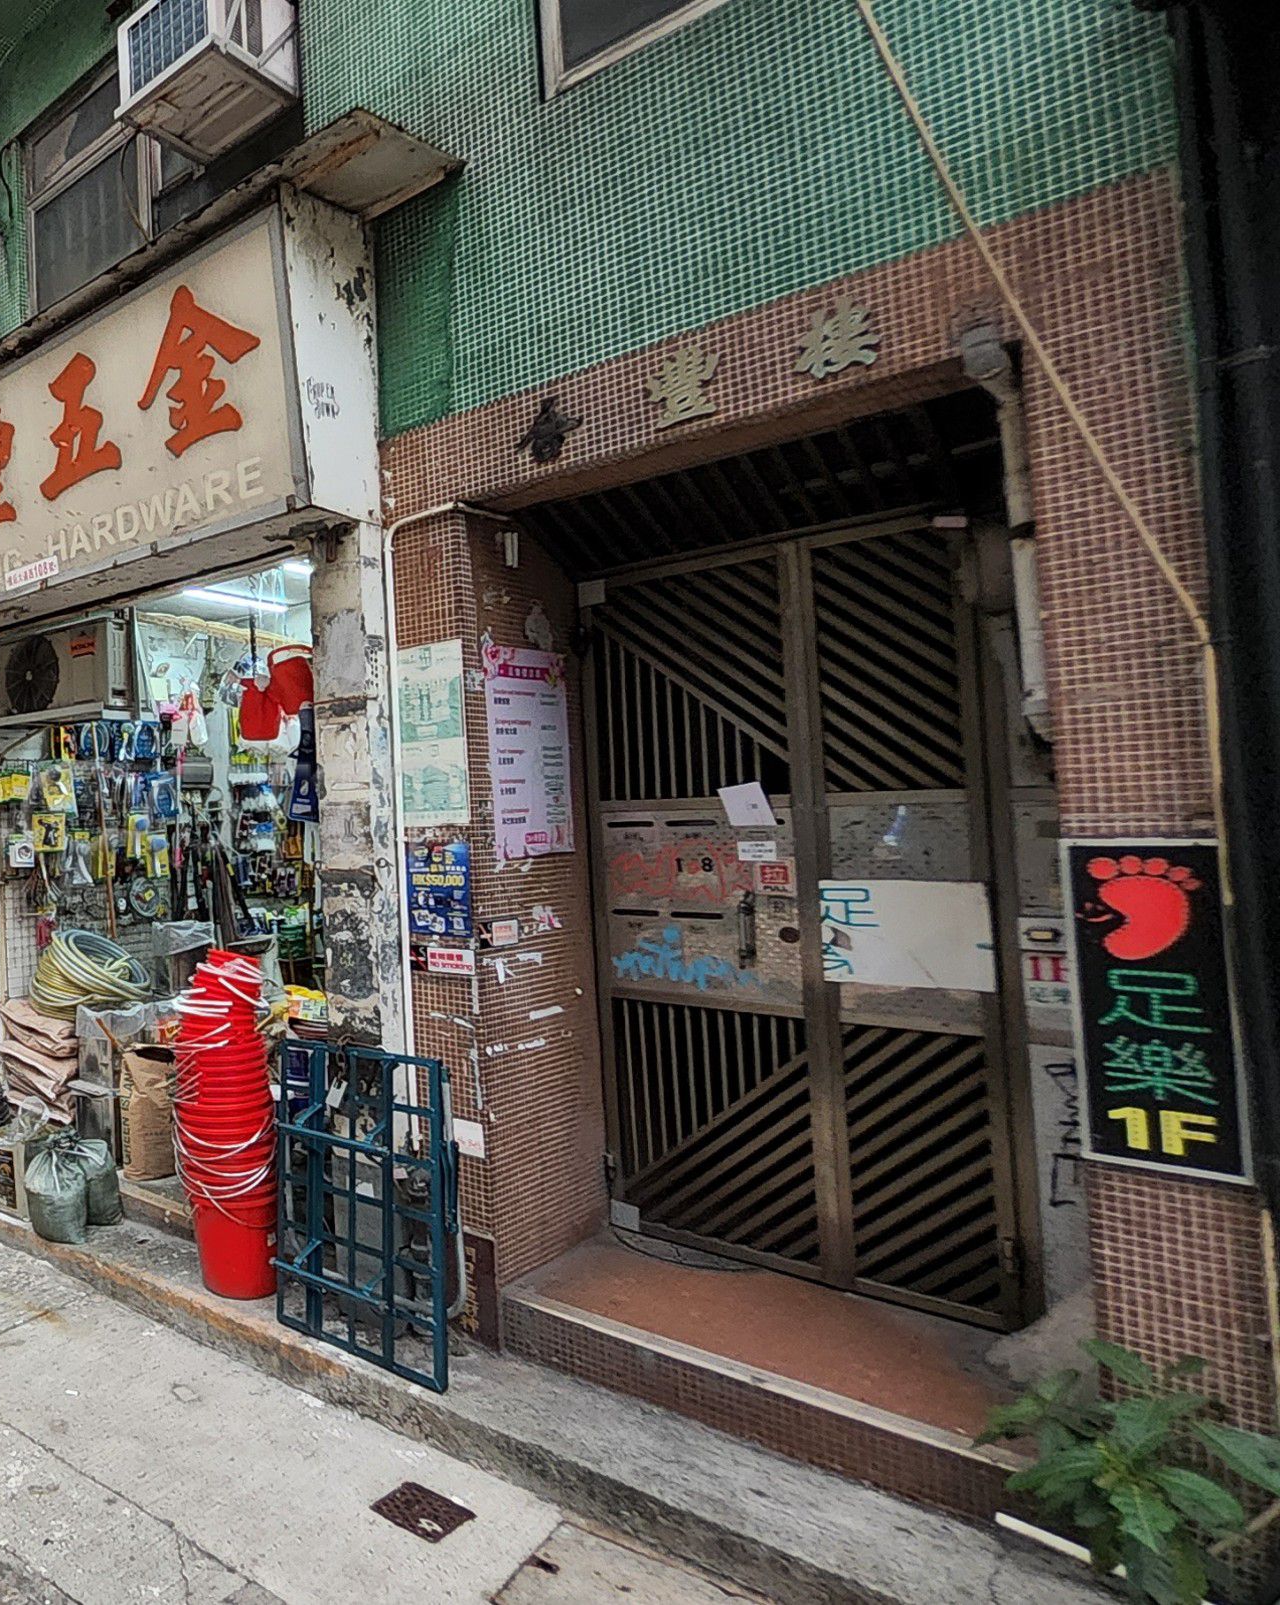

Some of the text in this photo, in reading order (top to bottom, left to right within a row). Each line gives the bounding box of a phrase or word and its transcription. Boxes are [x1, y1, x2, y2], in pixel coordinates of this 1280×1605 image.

[46, 455, 265, 564] HARDWARE
[1098, 968, 1220, 1106] 足樂
[1107, 1105, 1220, 1156] 1F
